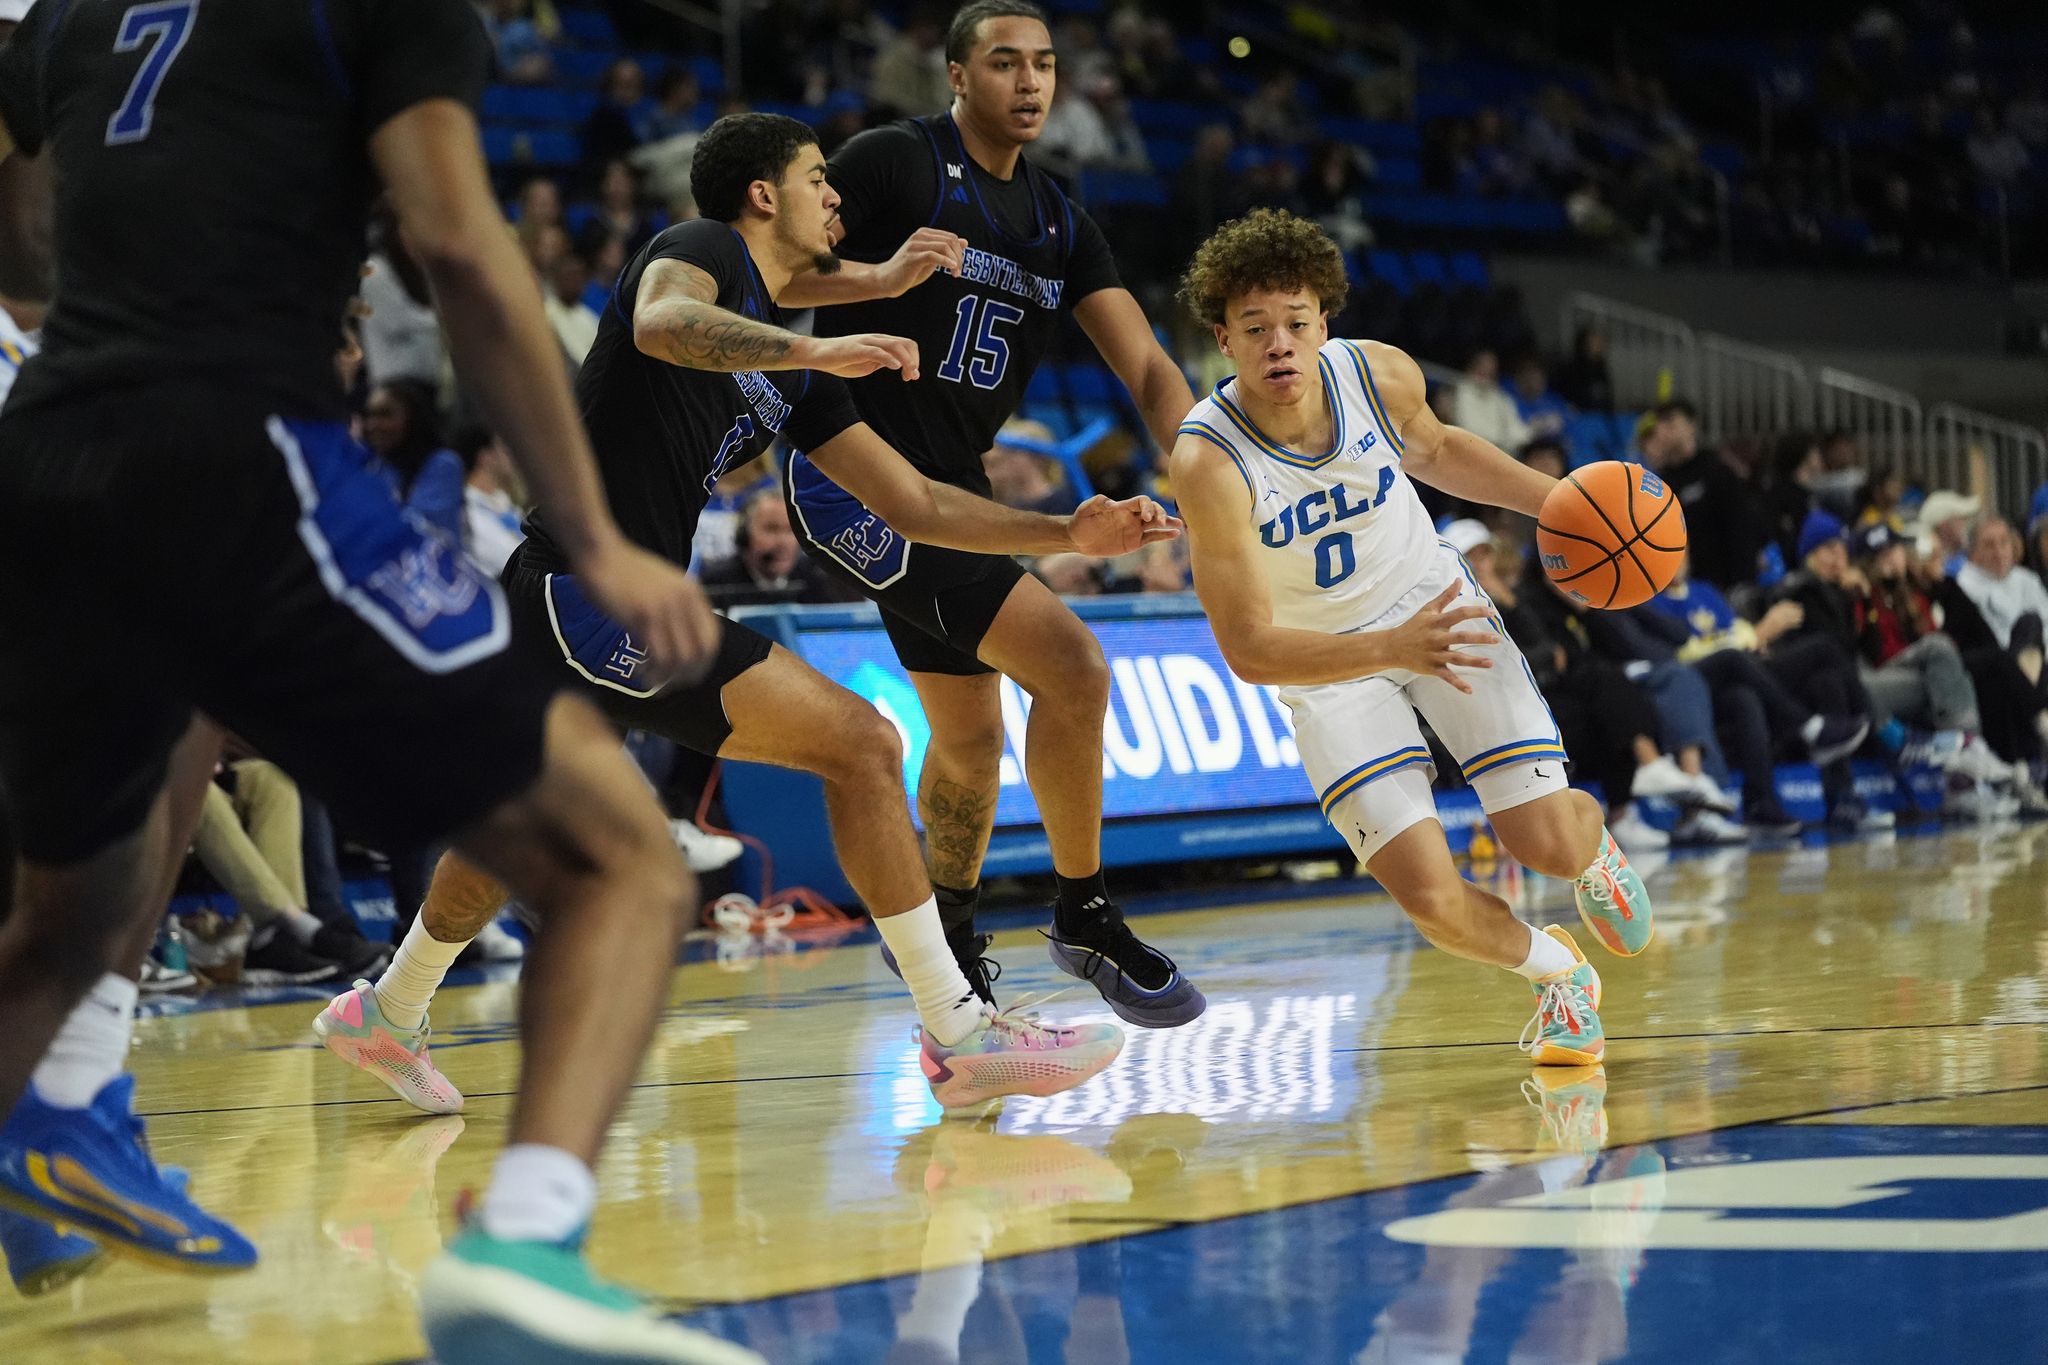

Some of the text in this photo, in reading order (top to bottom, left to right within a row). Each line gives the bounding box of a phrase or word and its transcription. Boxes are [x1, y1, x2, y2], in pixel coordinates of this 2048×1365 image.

[104, 0, 200, 147] 7
[937, 294, 1025, 391] 15
[1259, 465, 1396, 549] UCLA
[1314, 531, 1357, 590] 0
